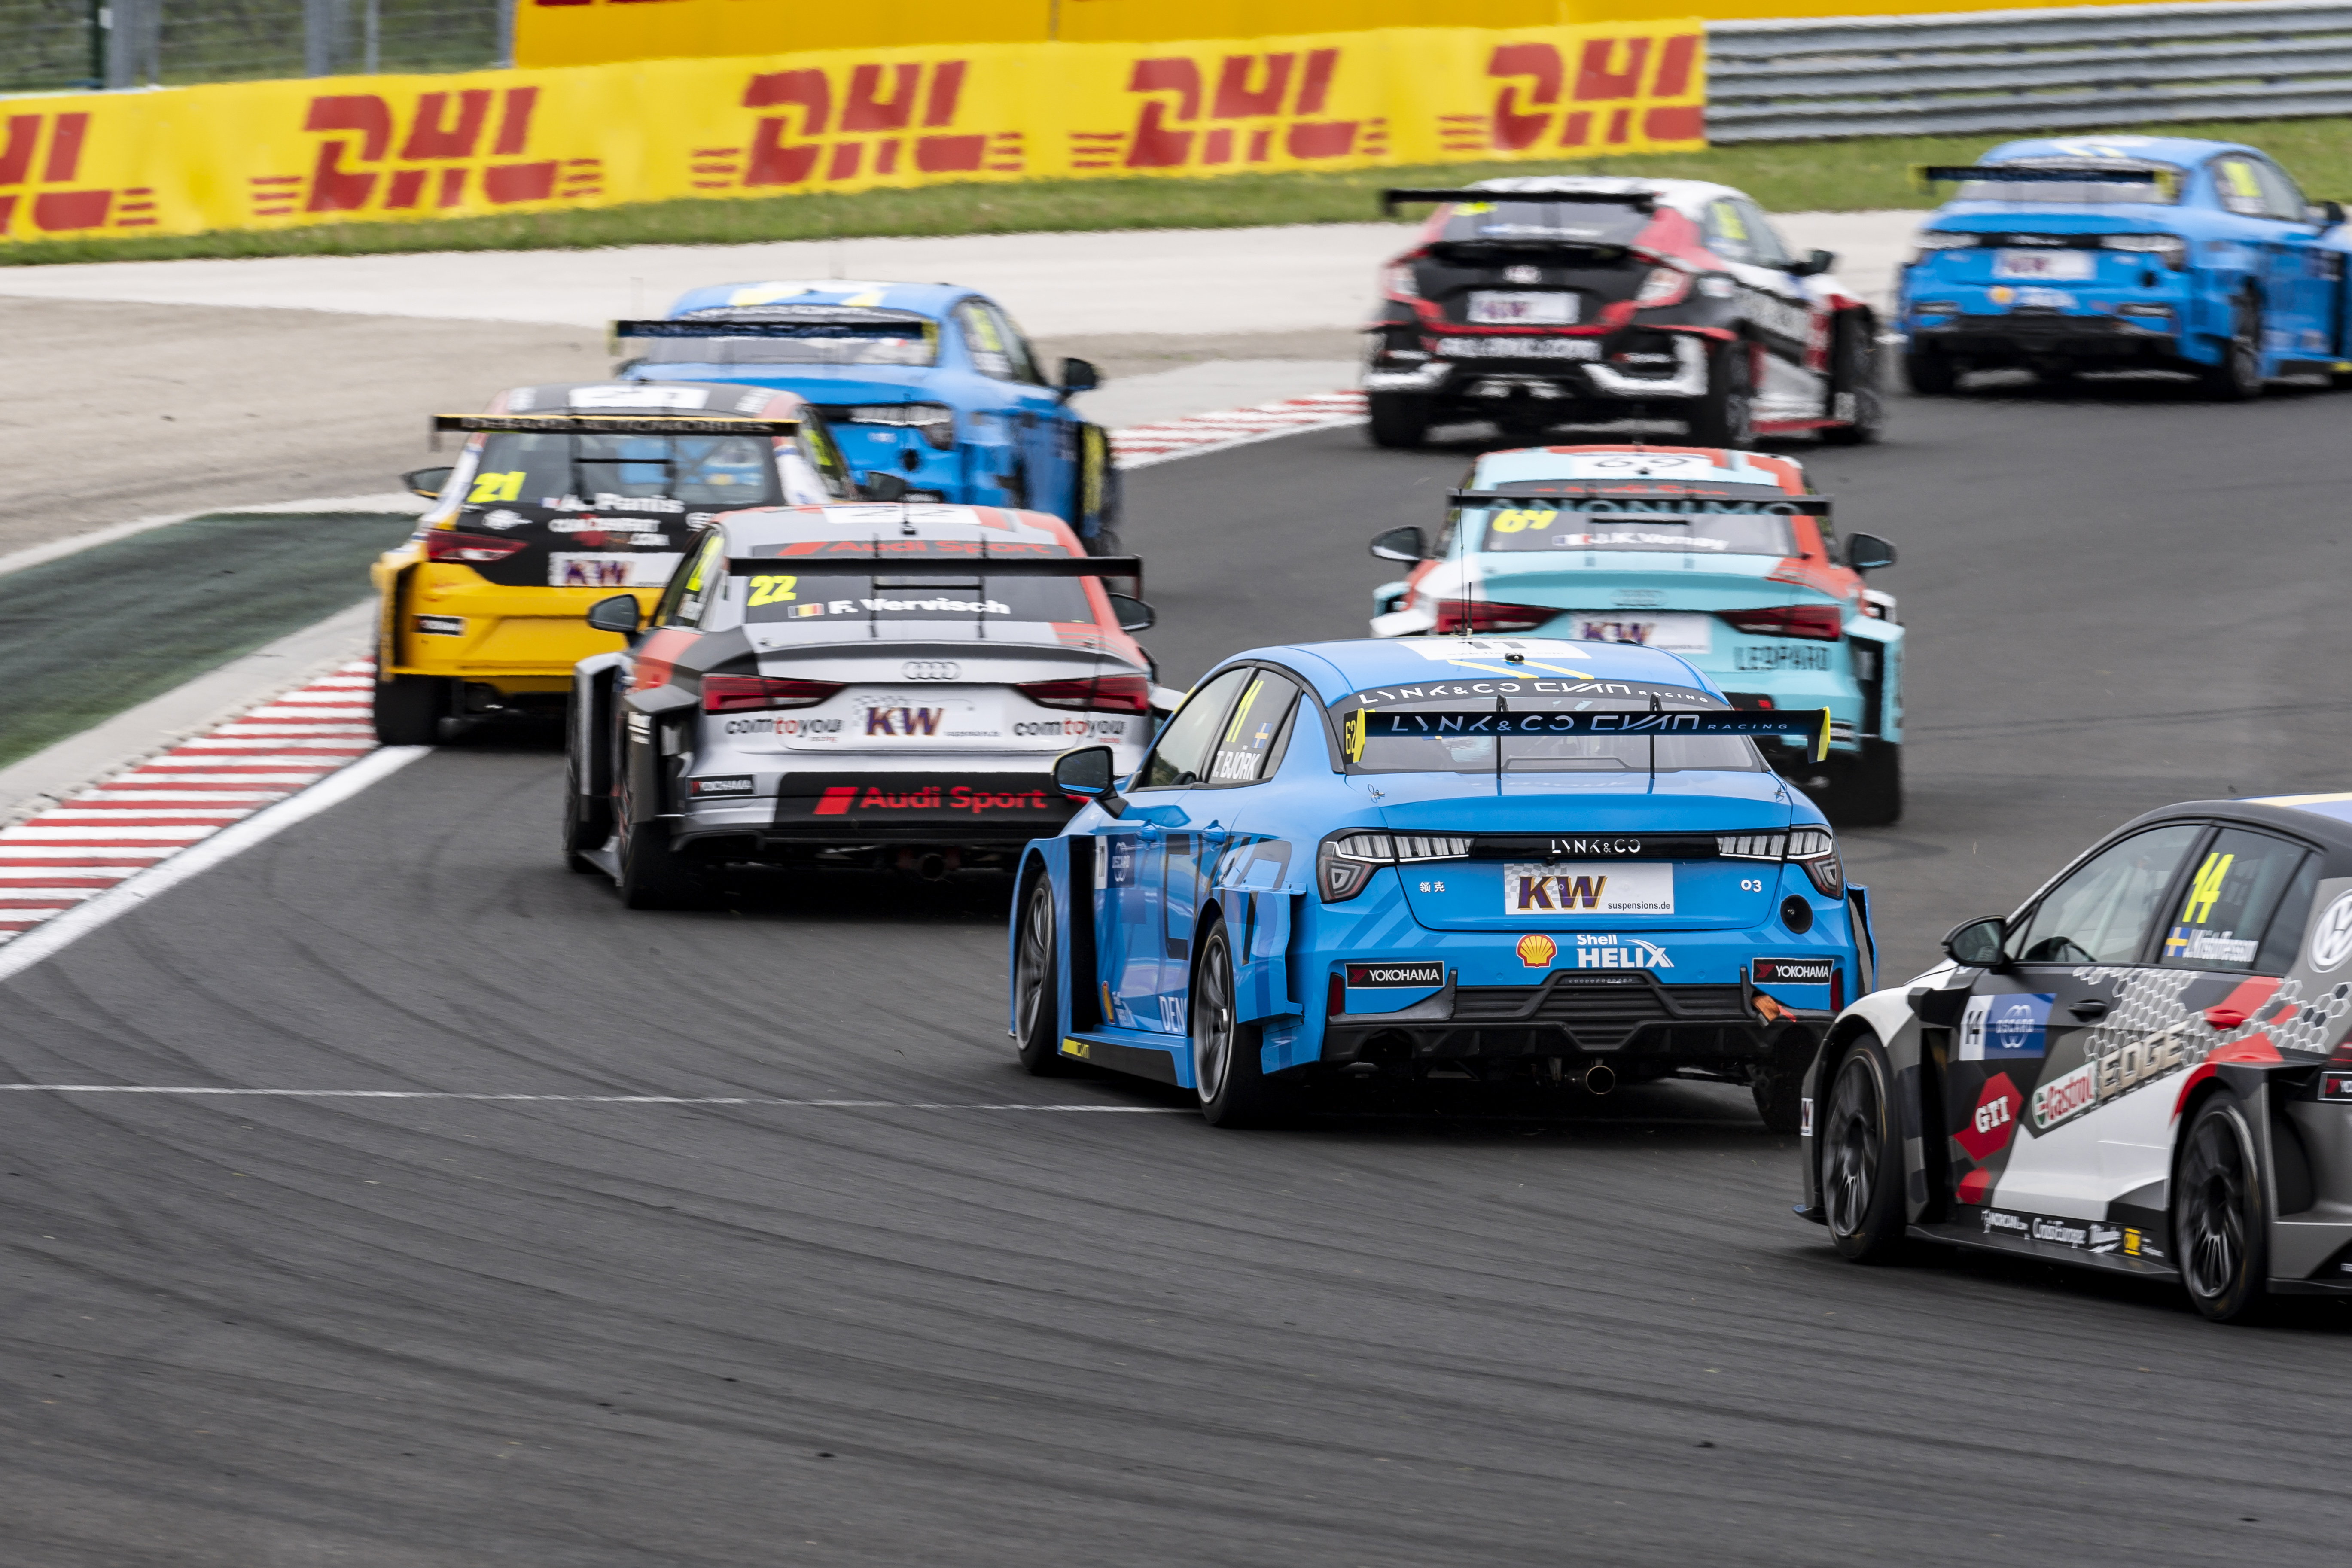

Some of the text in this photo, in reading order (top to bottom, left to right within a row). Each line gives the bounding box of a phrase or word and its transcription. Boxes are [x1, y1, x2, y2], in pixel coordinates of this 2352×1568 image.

[1124, 47, 1361, 168] DHL
[1487, 33, 1704, 151] DHL
[740, 59, 988, 187] DHL
[302, 86, 558, 213] DHL
[467, 471, 527, 503] 21
[826, 540, 1052, 554] Audi Sport
[747, 575, 797, 606] 22
[827, 597, 1011, 615] F. Vervisch
[1225, 679, 1264, 743] 11
[1638, 690, 1709, 703] RACING
[724, 716, 845, 738] comtoyou
[863, 706, 945, 737] KW
[1212, 744, 1262, 780] T. BJÖRK
[859, 786, 1048, 814] Audi Sport
[1517, 875, 1608, 910] KW
[2181, 852, 2235, 924] 14
[1608, 901, 1670, 911] suspensions.de
[1577, 934, 1618, 945] Shell
[1577, 944, 1675, 968] HELIX
[1775, 965, 1829, 977] YOKOHAMA
[1369, 968, 1440, 981] YOKOHAMA
[1975, 1096, 2011, 1133] GTI
